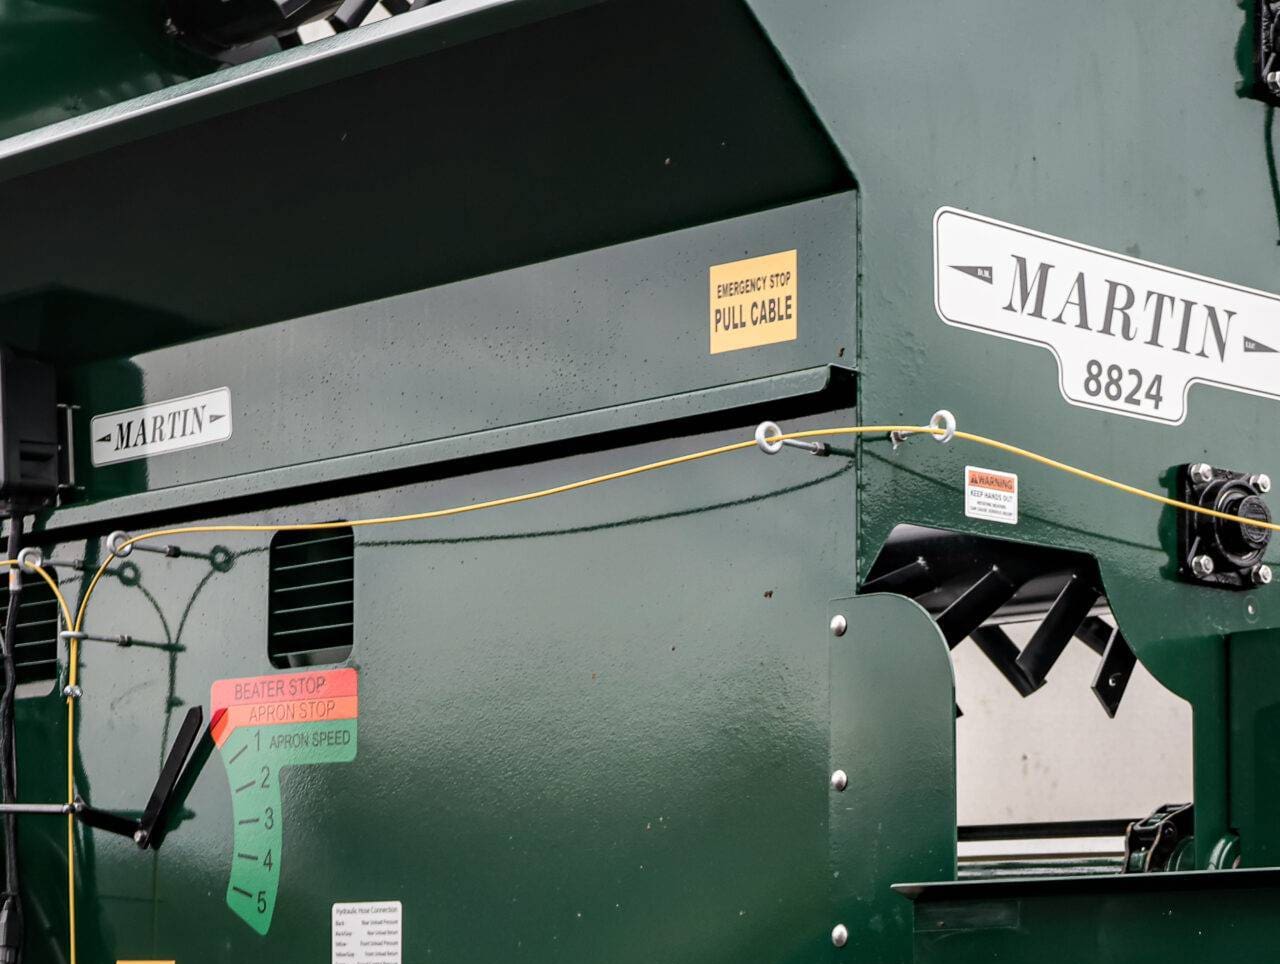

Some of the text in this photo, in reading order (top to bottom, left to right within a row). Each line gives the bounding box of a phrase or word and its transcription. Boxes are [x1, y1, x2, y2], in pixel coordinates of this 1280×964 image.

[717, 271, 791, 299] EMERGENCY STOP
[715, 295, 792, 333] PULL CABLE
[1002, 254, 1237, 363] MARTIN
[1083, 359, 1163, 410] 8824
[114, 405, 206, 451] MARTIN
[978, 474, 1012, 490] WARNING
[970, 490, 984, 498] KEEP
[984, 492, 1002, 501] HANDS
[234, 675, 326, 700] BEATER STOP
[250, 699, 336, 722] APRON STOP
[254, 729, 351, 752] 1 APRON SPEED
[261, 765, 270, 789] 2
[264, 806, 274, 830] 3
[263, 849, 273, 872] 4
[257, 890, 266, 914] 5
[370, 906, 398, 914] Connection
